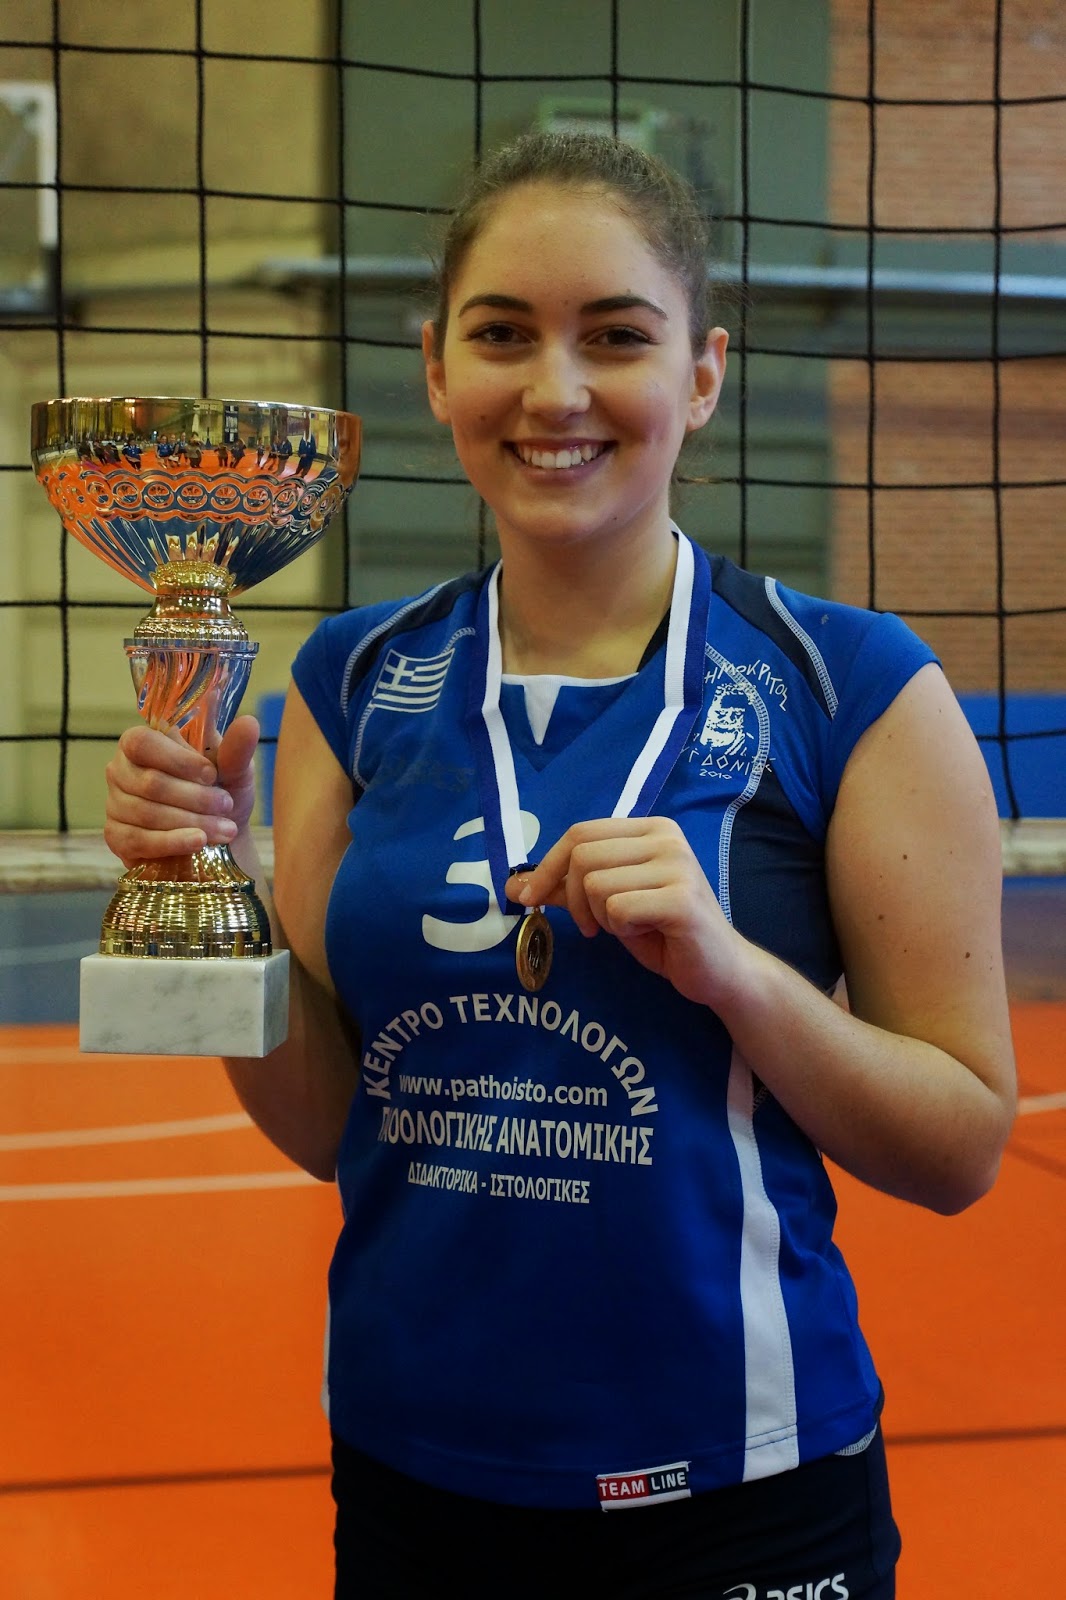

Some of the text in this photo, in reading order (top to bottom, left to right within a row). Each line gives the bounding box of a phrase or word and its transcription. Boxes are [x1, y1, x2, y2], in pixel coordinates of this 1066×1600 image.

[699, 768, 733, 780] 2010
[422, 809, 541, 953] 3
[363, 993, 659, 1117] ΚΕΝΤΡΟ ΤΕΧΝΟΛΟΓΩΝ
[399, 1075, 608, 1107] www.pathoisto.com
[496, 1117, 654, 1166] ΑΝΑΤΟΜΙΚΗΣ
[407, 1161, 478, 1194] ΔΙΔΑΚΤΟΡΙΚΑ
[490, 1173, 590, 1204] ΙΣΤΟΛΟΓΙΚΕΣ
[599, 1471, 687, 1497] TEAM LINE
